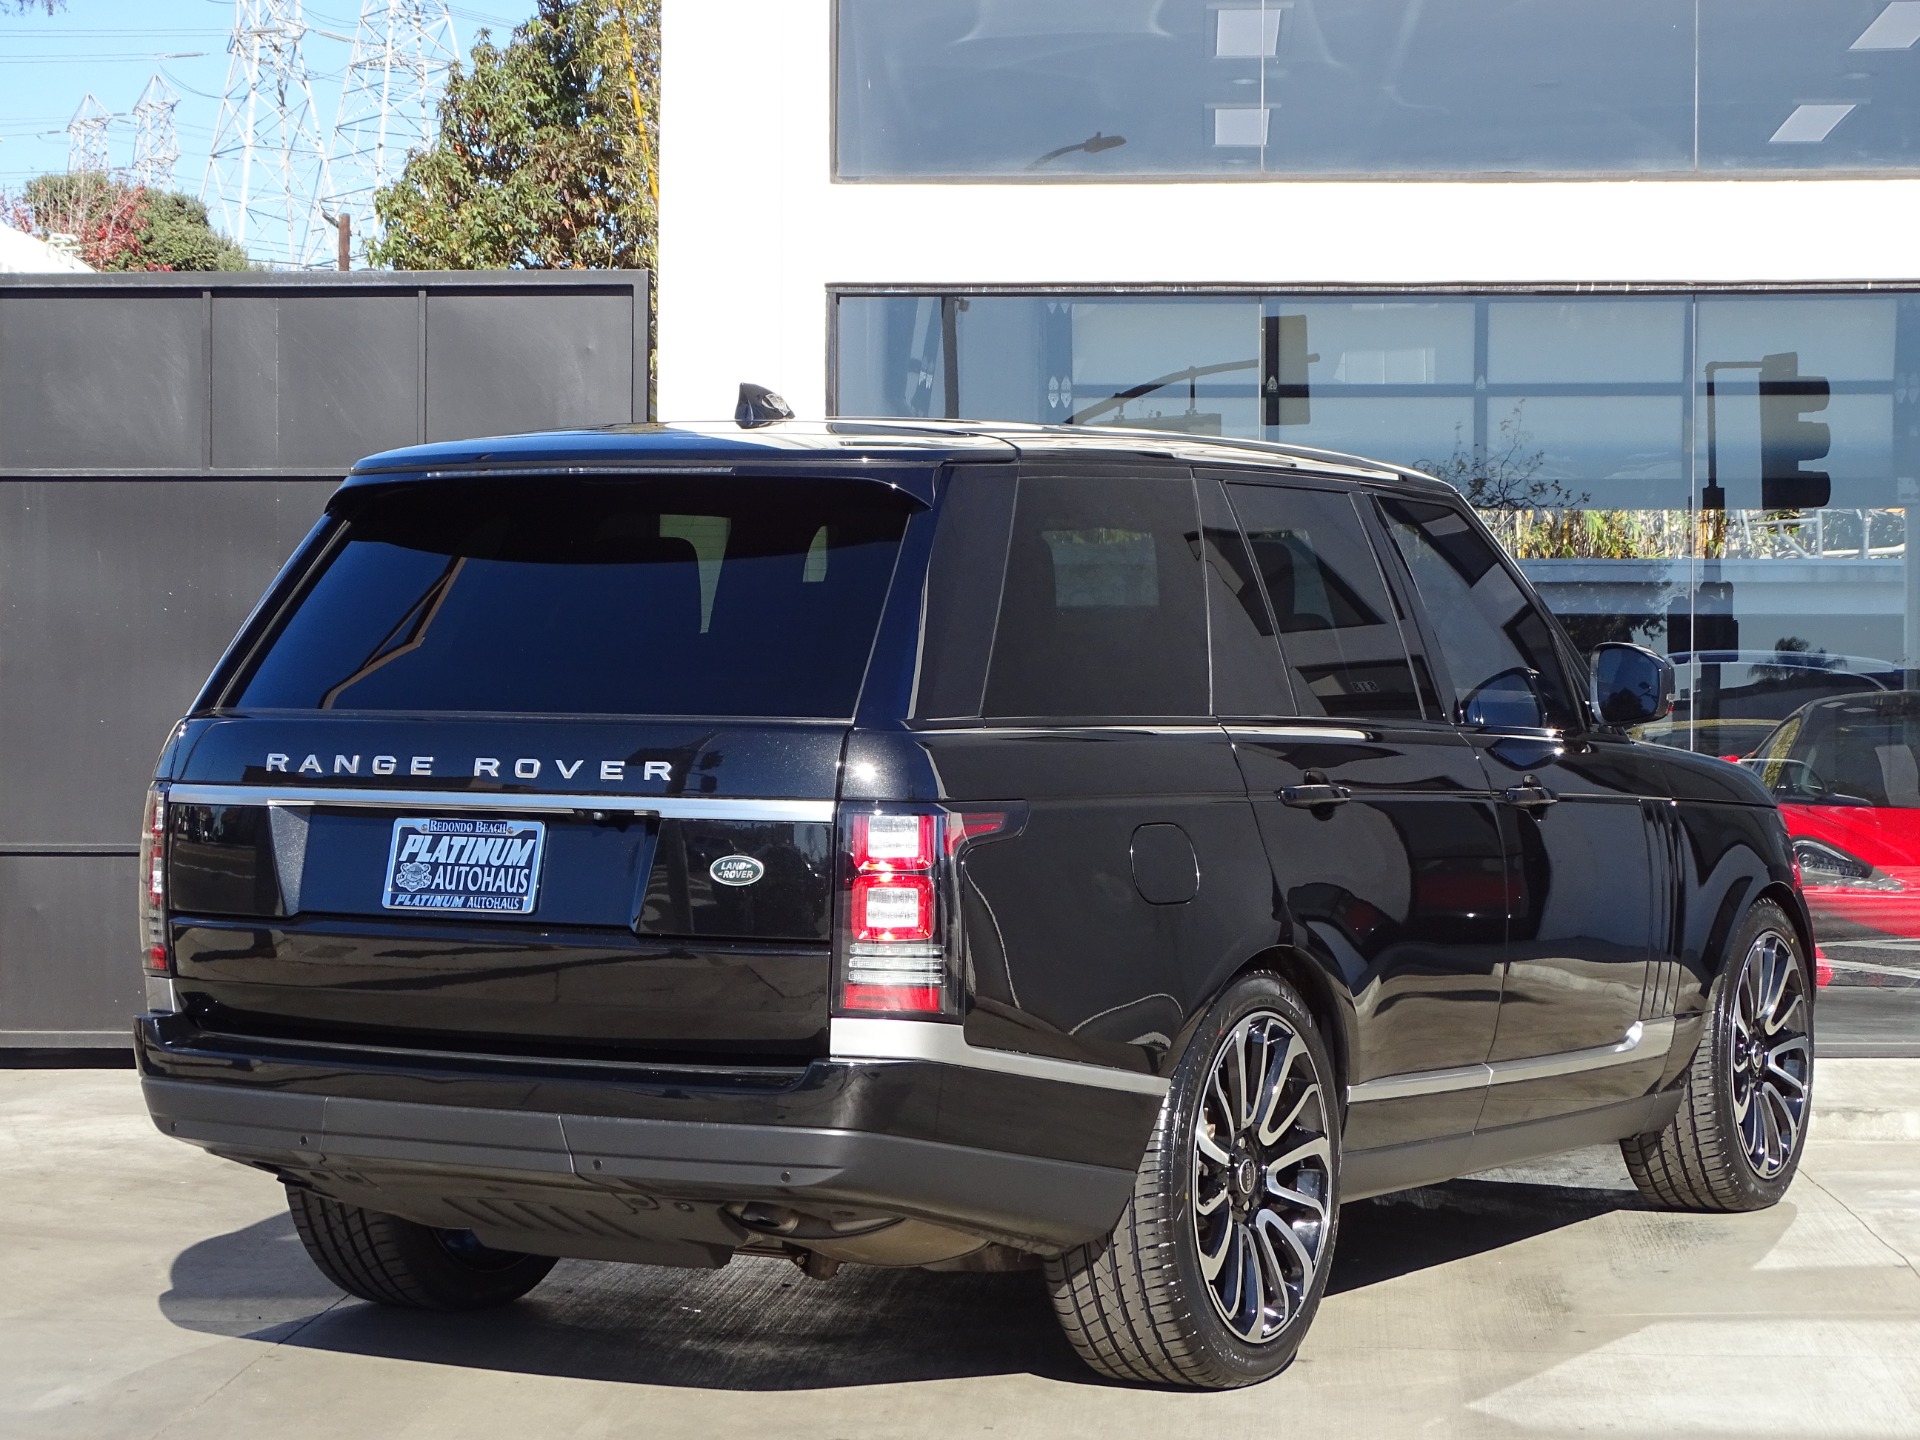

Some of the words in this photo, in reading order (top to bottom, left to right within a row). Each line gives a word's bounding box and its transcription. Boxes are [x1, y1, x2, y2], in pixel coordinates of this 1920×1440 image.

[266, 753, 434, 775] RANGE
[474, 757, 672, 781] ROVER
[429, 819, 473, 833] REDONDO
[475, 821, 507, 834] BEACH
[399, 835, 536, 867] PLATINUM
[721, 862, 747, 870] LAND
[722, 870, 754, 879] ROVER
[431, 865, 530, 894] AUTOHAUS
[394, 894, 465, 908] PLATINUM
[466, 897, 519, 911] AUTOHAUS
